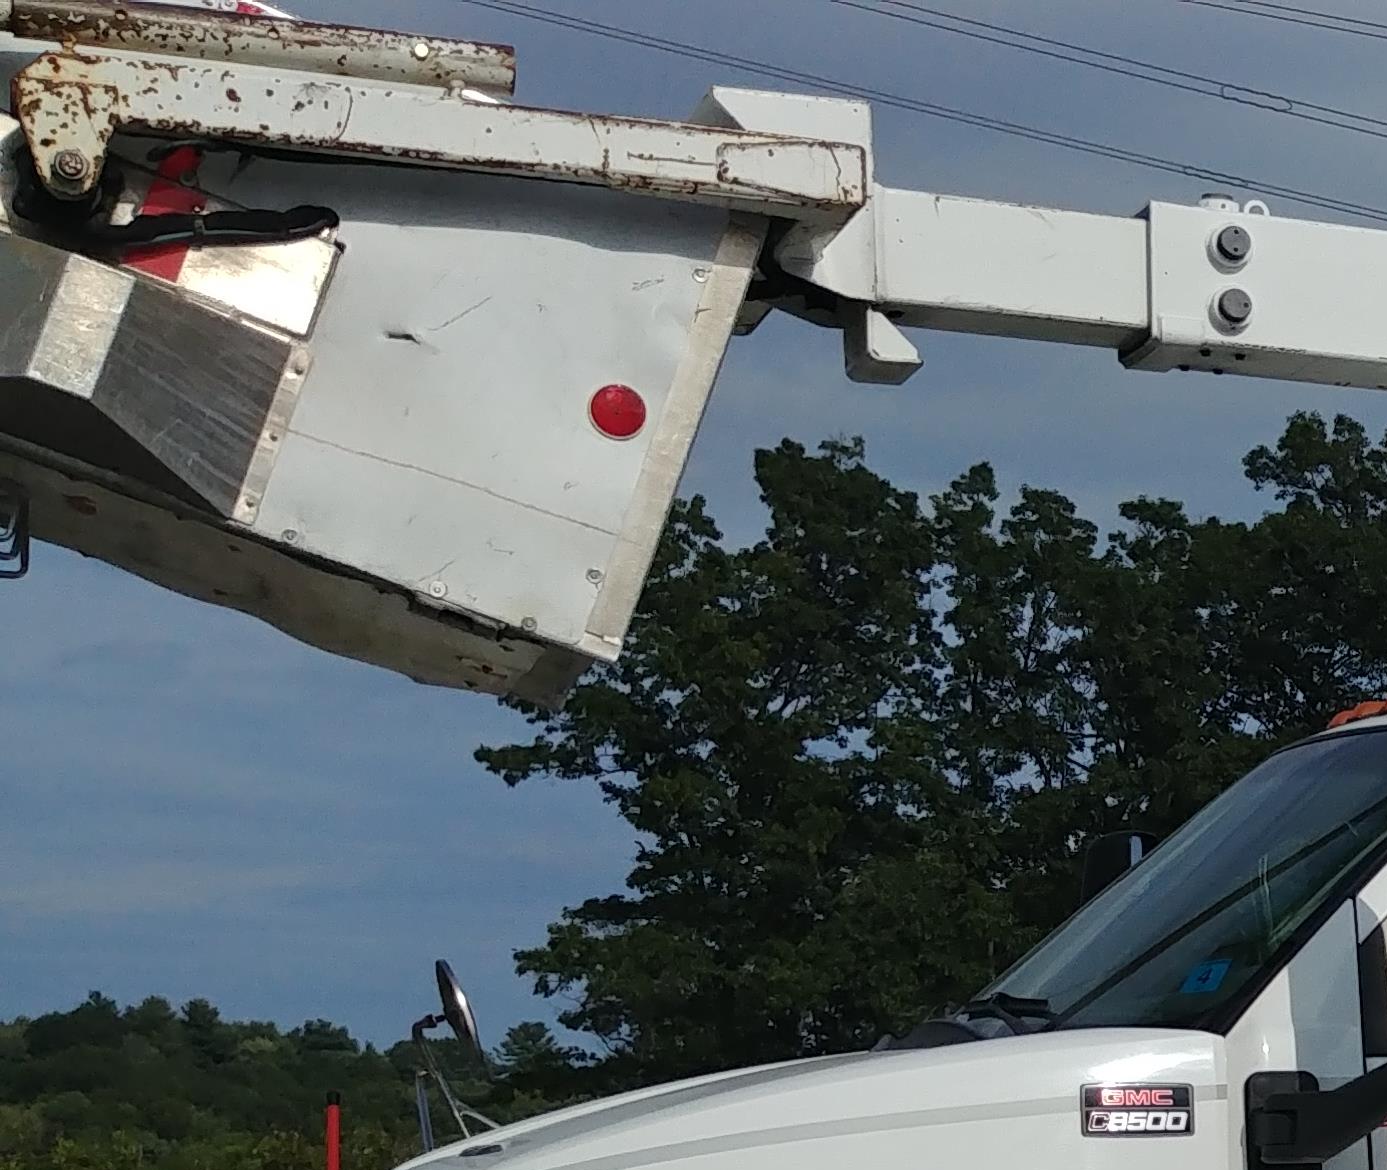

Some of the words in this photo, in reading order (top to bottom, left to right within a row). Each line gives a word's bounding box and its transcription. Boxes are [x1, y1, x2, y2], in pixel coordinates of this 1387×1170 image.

[1197, 968, 1213, 984] 4
[1101, 1089, 1173, 1105] GMC
[1088, 1111, 1188, 1131] C8500
